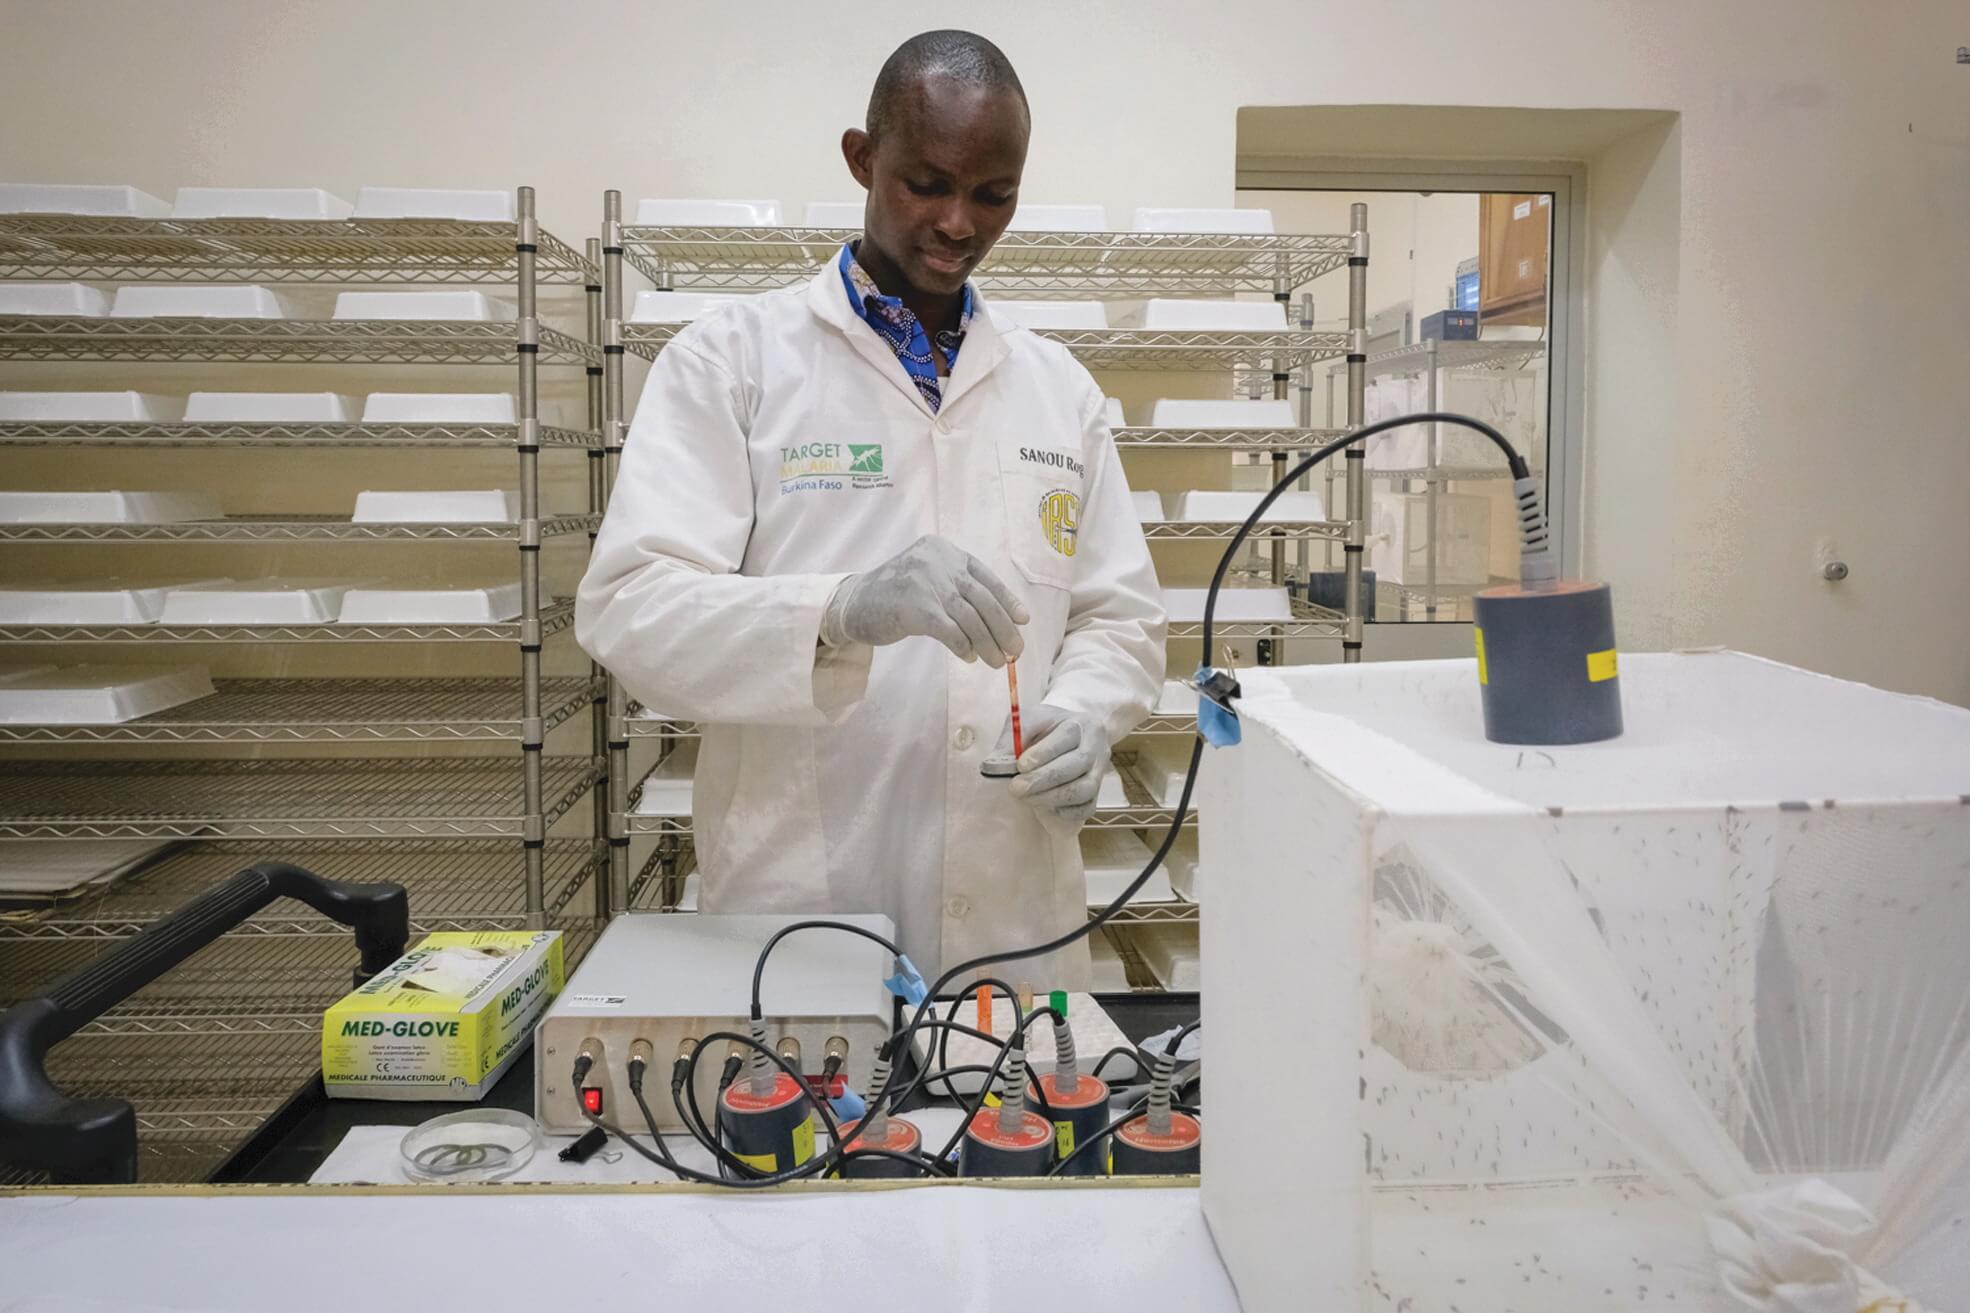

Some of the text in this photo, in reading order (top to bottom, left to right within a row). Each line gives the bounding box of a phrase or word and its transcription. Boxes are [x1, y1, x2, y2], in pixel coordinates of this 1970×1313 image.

[780, 442, 841, 462] TARGET
[1019, 447, 1064, 468] SANOU
[778, 459, 842, 478] MALARIA
[781, 478, 843, 496] Burkina Faso
[501, 959, 550, 1017] MED-GLOVE
[341, 1020, 460, 1038] MED-GLOVE
[328, 1074, 446, 1082] MEDICALE PHARMACEUTIQUE
